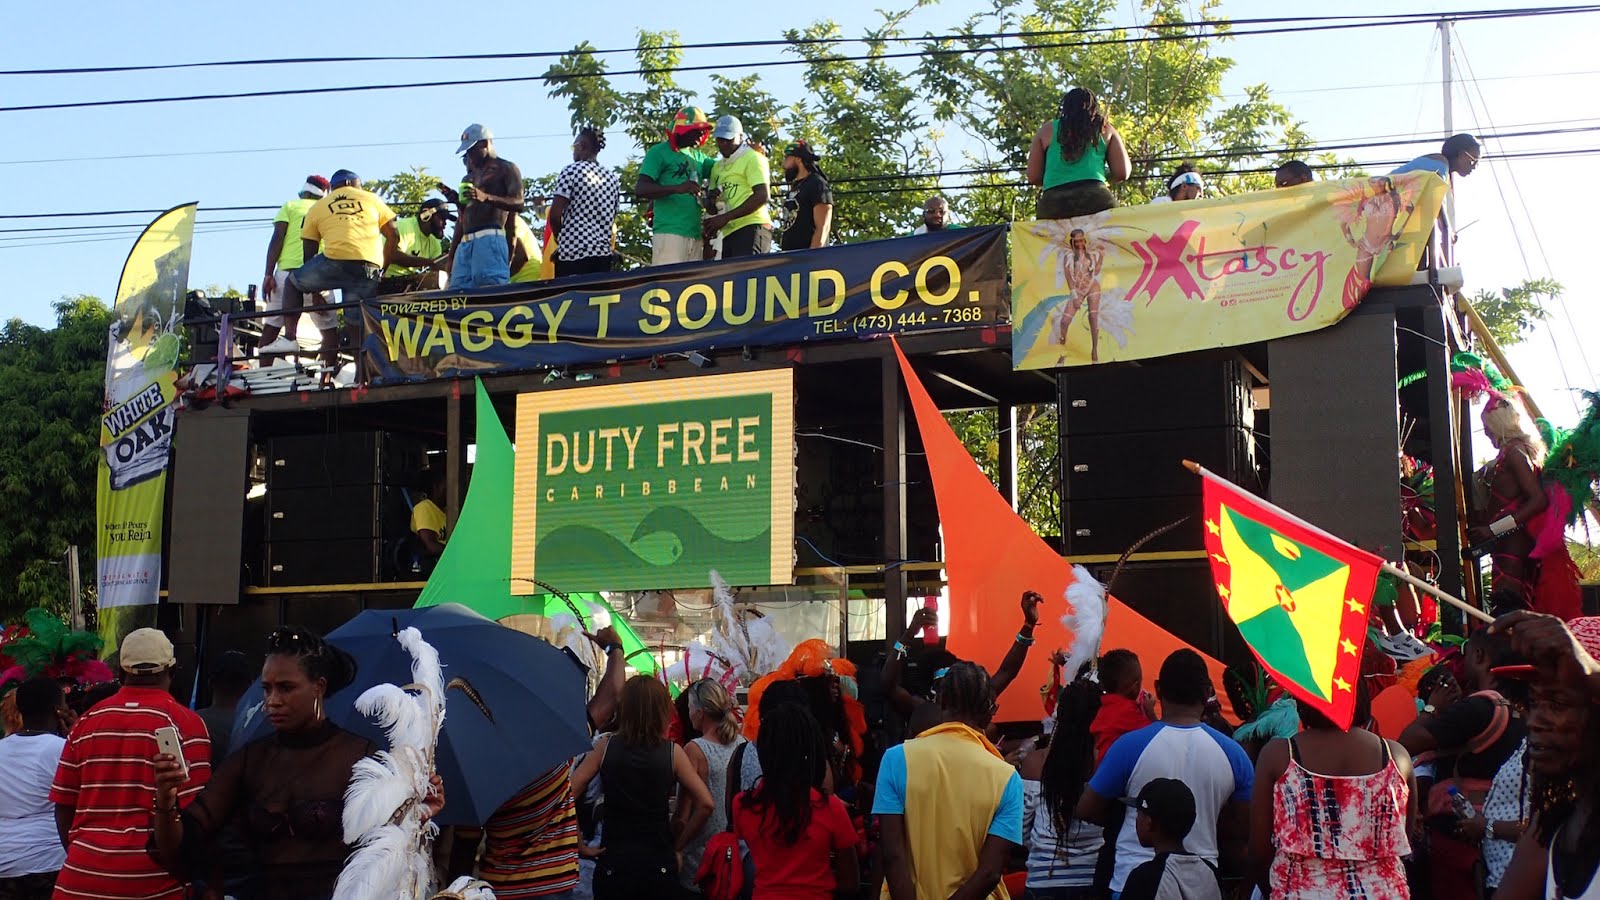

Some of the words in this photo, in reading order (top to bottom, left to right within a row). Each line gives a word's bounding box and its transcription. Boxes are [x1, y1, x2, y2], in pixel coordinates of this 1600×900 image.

[1124, 220, 1332, 322] Xtascy
[381, 300, 448, 316] POWERED
[452, 297, 468, 311] BY
[381, 300, 572, 362] WAGGY
[589, 293, 622, 338] T
[637, 269, 846, 334] SOUND
[870, 256, 981, 310] CO.
[813, 320, 848, 334] TEL:
[853, 314, 893, 333] (473)
[897, 311, 927, 327] 444
[942, 307, 982, 323] 7368
[104, 382, 165, 438] WHITE
[116, 410, 171, 463] OAK
[545, 425, 644, 476] DUTY
[657, 415, 760, 468] FREE
[546, 474, 756, 502] CARIBBEAN
[109, 532, 126, 544] you
[128, 529, 152, 543] Reign
